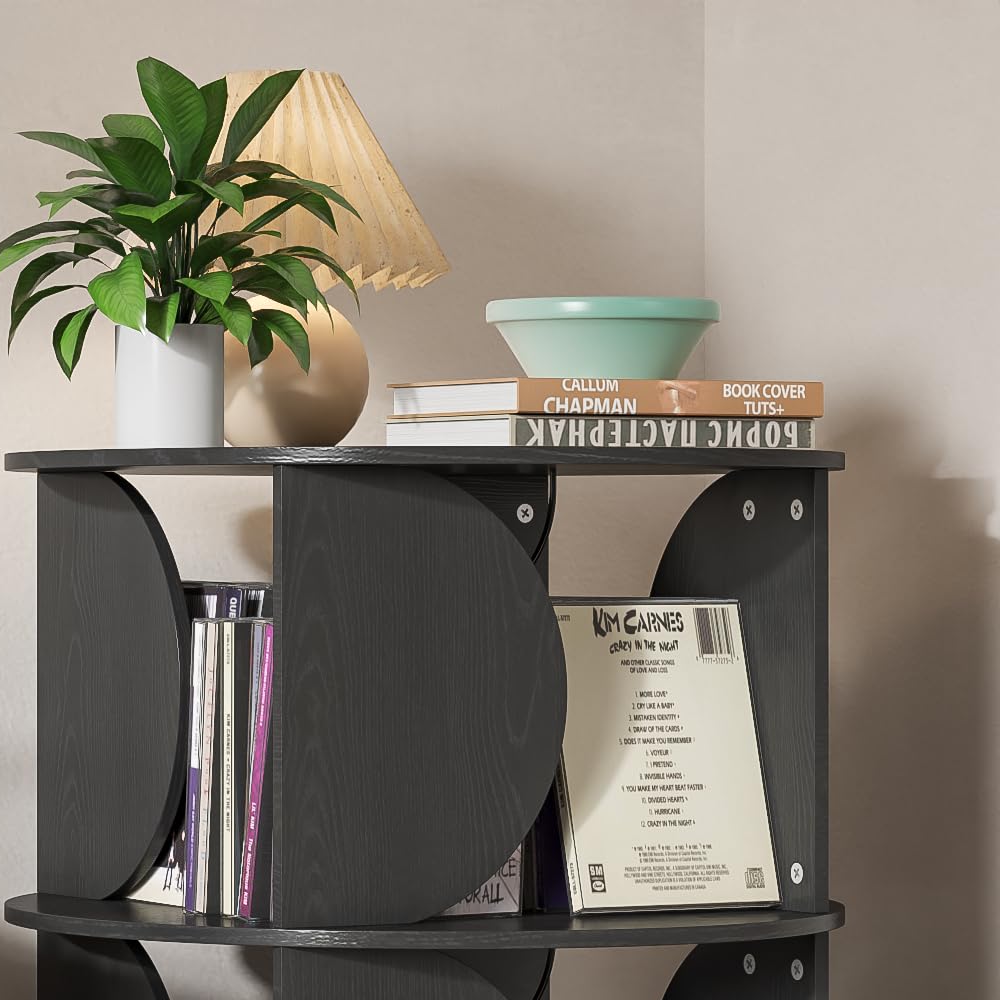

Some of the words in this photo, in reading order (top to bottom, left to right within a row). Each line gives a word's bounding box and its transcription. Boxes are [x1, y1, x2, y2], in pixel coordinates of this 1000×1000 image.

[563, 379, 619, 392] CALLUM
[723, 384, 760, 398] BOOK
[763, 384, 806, 399] COVER
[543, 397, 637, 415] CHAPMAN
[744, 401, 785, 415] TUTS+
[592, 607, 620, 637] KIM
[624, 609, 684, 634] CARNES
[610, 640, 631, 654] CRAZY
[635, 640, 642, 650] IN
[644, 640, 656, 651] THE
[659, 640, 679, 652] NIGHT
